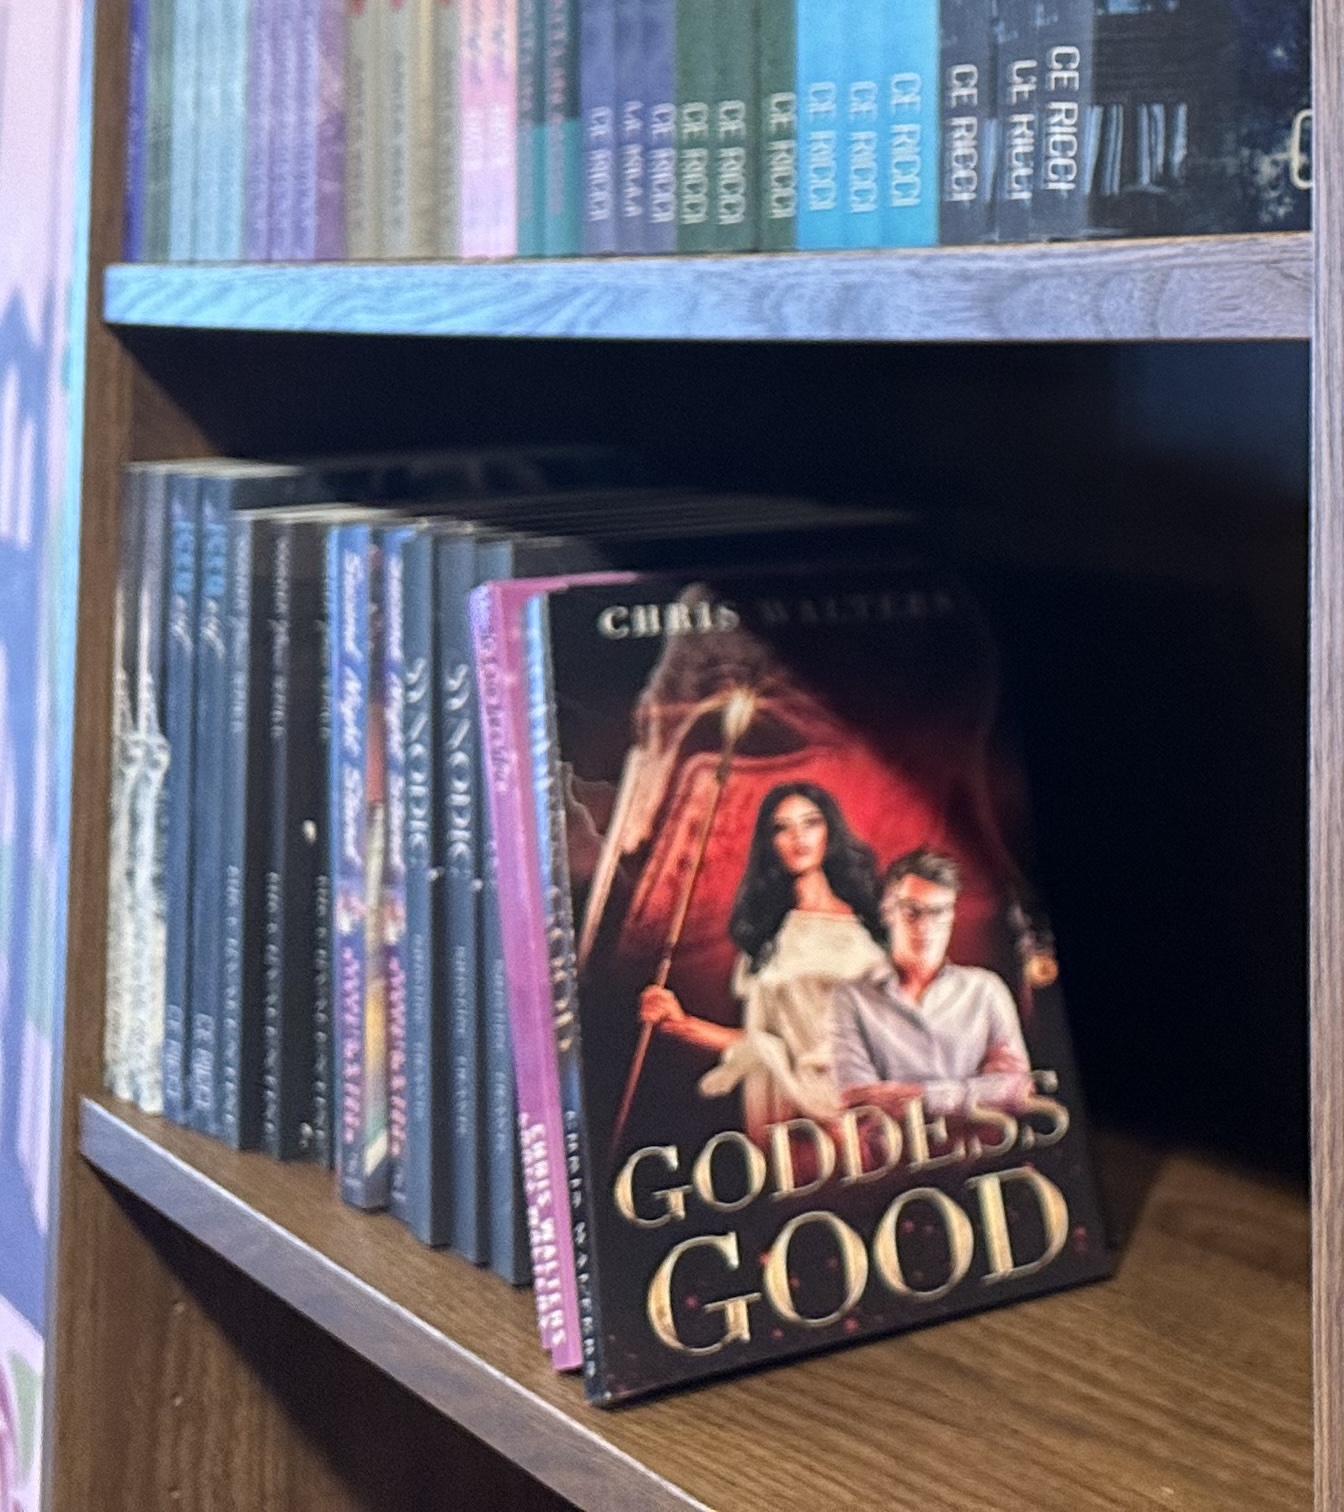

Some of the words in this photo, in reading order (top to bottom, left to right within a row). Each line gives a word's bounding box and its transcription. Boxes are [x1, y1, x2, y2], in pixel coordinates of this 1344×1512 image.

[809, 81, 836, 121] CE
[849, 81, 878, 121] CE
[891, 72, 921, 115] CE
[948, 64, 978, 109] CE
[1047, 45, 1080, 92] CE
[682, 102, 709, 143] CE
[718, 100, 746, 140] CE
[769, 92, 797, 134] CE
[1043, 101, 1078, 192] RICCI
[682, 148, 709, 225] RICCI
[718, 146, 745, 225] RICCI
[768, 139, 797, 220] RICCI
[809, 130, 836, 211] RICCI
[850, 131, 878, 213] RICCI
[890, 124, 921, 207] RICCI
[945, 116, 977, 202] RICCI
[597, 582, 740, 639] CHRIS
[613, 1070, 1070, 1227] GODDESS
[530, 1123, 552, 1207] CHRIS
[541, 1217, 565, 1346] WALTERS
[647, 1162, 1070, 1357] GOOD
